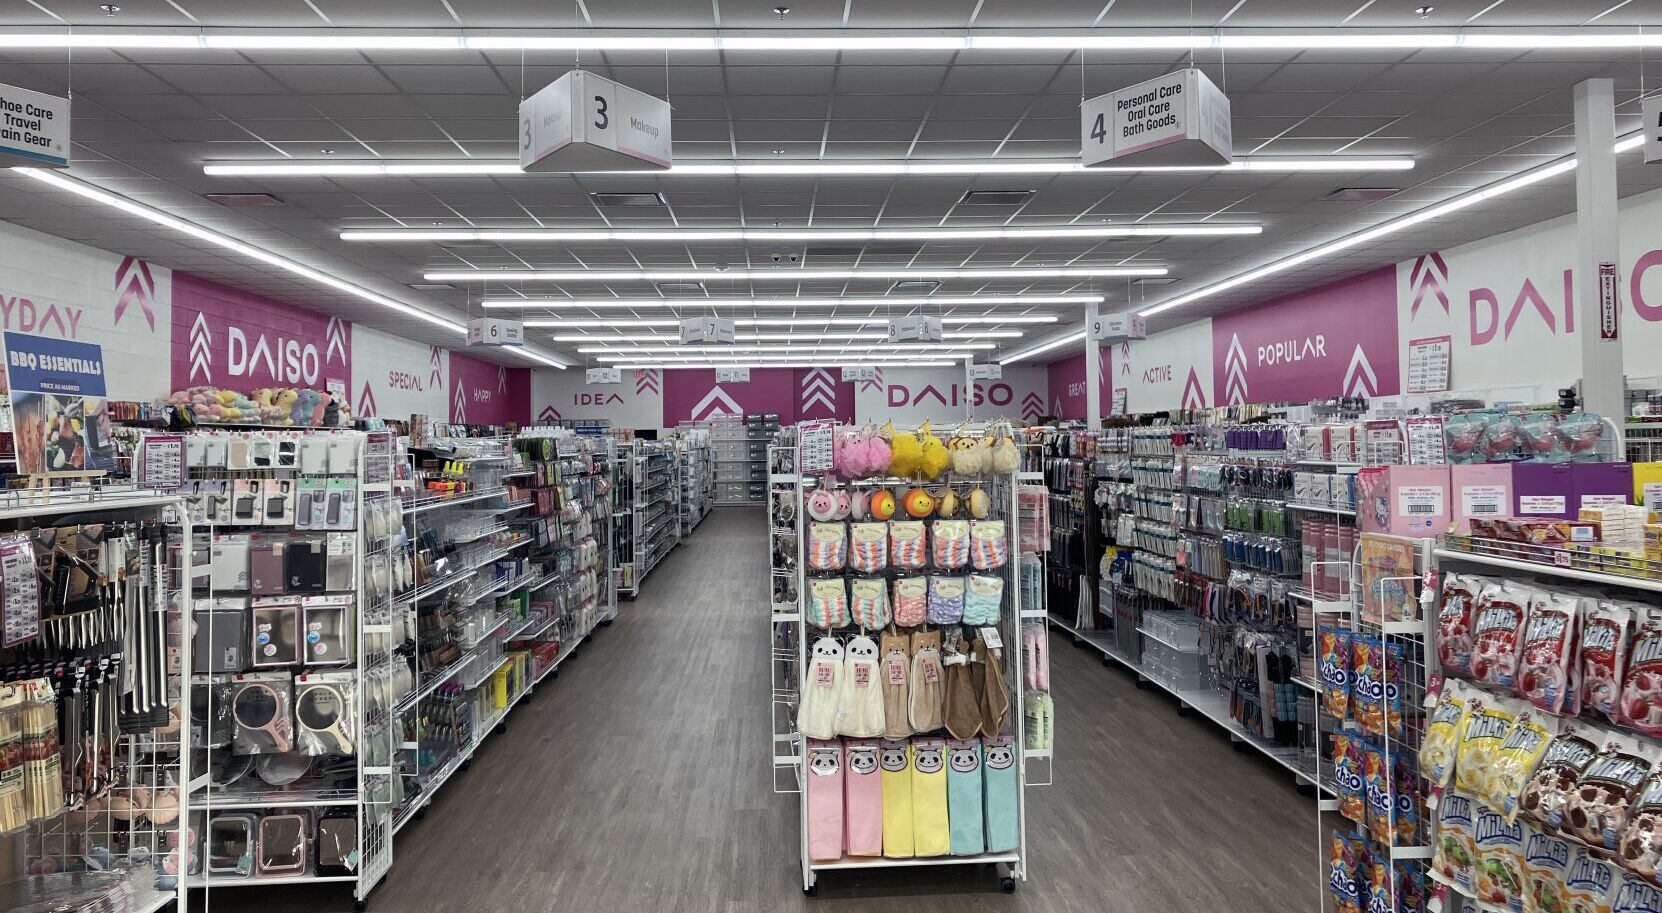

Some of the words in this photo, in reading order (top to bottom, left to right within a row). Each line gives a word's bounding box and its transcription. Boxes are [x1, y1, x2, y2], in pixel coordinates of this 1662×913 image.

[1117, 88, 1157, 112] Personal
[1159, 83, 1182, 98] Care
[26, 104, 53, 120] Care
[594, 95, 609, 130] 3
[1127, 108, 1146, 122] Oral
[1148, 101, 1170, 116] Care
[4, 113, 41, 132] Travel
[630, 116, 659, 139] Makeup
[1090, 112, 1106, 144] 4
[1123, 122, 1144, 138] Bath
[1146, 113, 1176, 131] Goods
[0, 127, 20, 141] ain
[24, 132, 52, 148] Gear
[523, 118, 532, 150] 3
[1600, 268, 1615, 276] FIRE
[490, 325, 497, 338] 6
[710, 323, 715, 336] 7
[890, 324, 896, 337] 8
[1094, 322, 1101, 334] 9
[228, 326, 319, 386] DAISO
[1257, 334, 1327, 368] POPULAR
[9, 350, 37, 371] BBQ
[39, 354, 102, 376] ESSENTIALS
[388, 370, 423, 392] SPECIAL
[1142, 364, 1172, 384] ACTIVE
[62, 384, 80, 392] MARKED
[473, 388, 492, 404] HAPPY
[888, 383, 1014, 408] DAISO
[574, 392, 624, 406] IDEA
